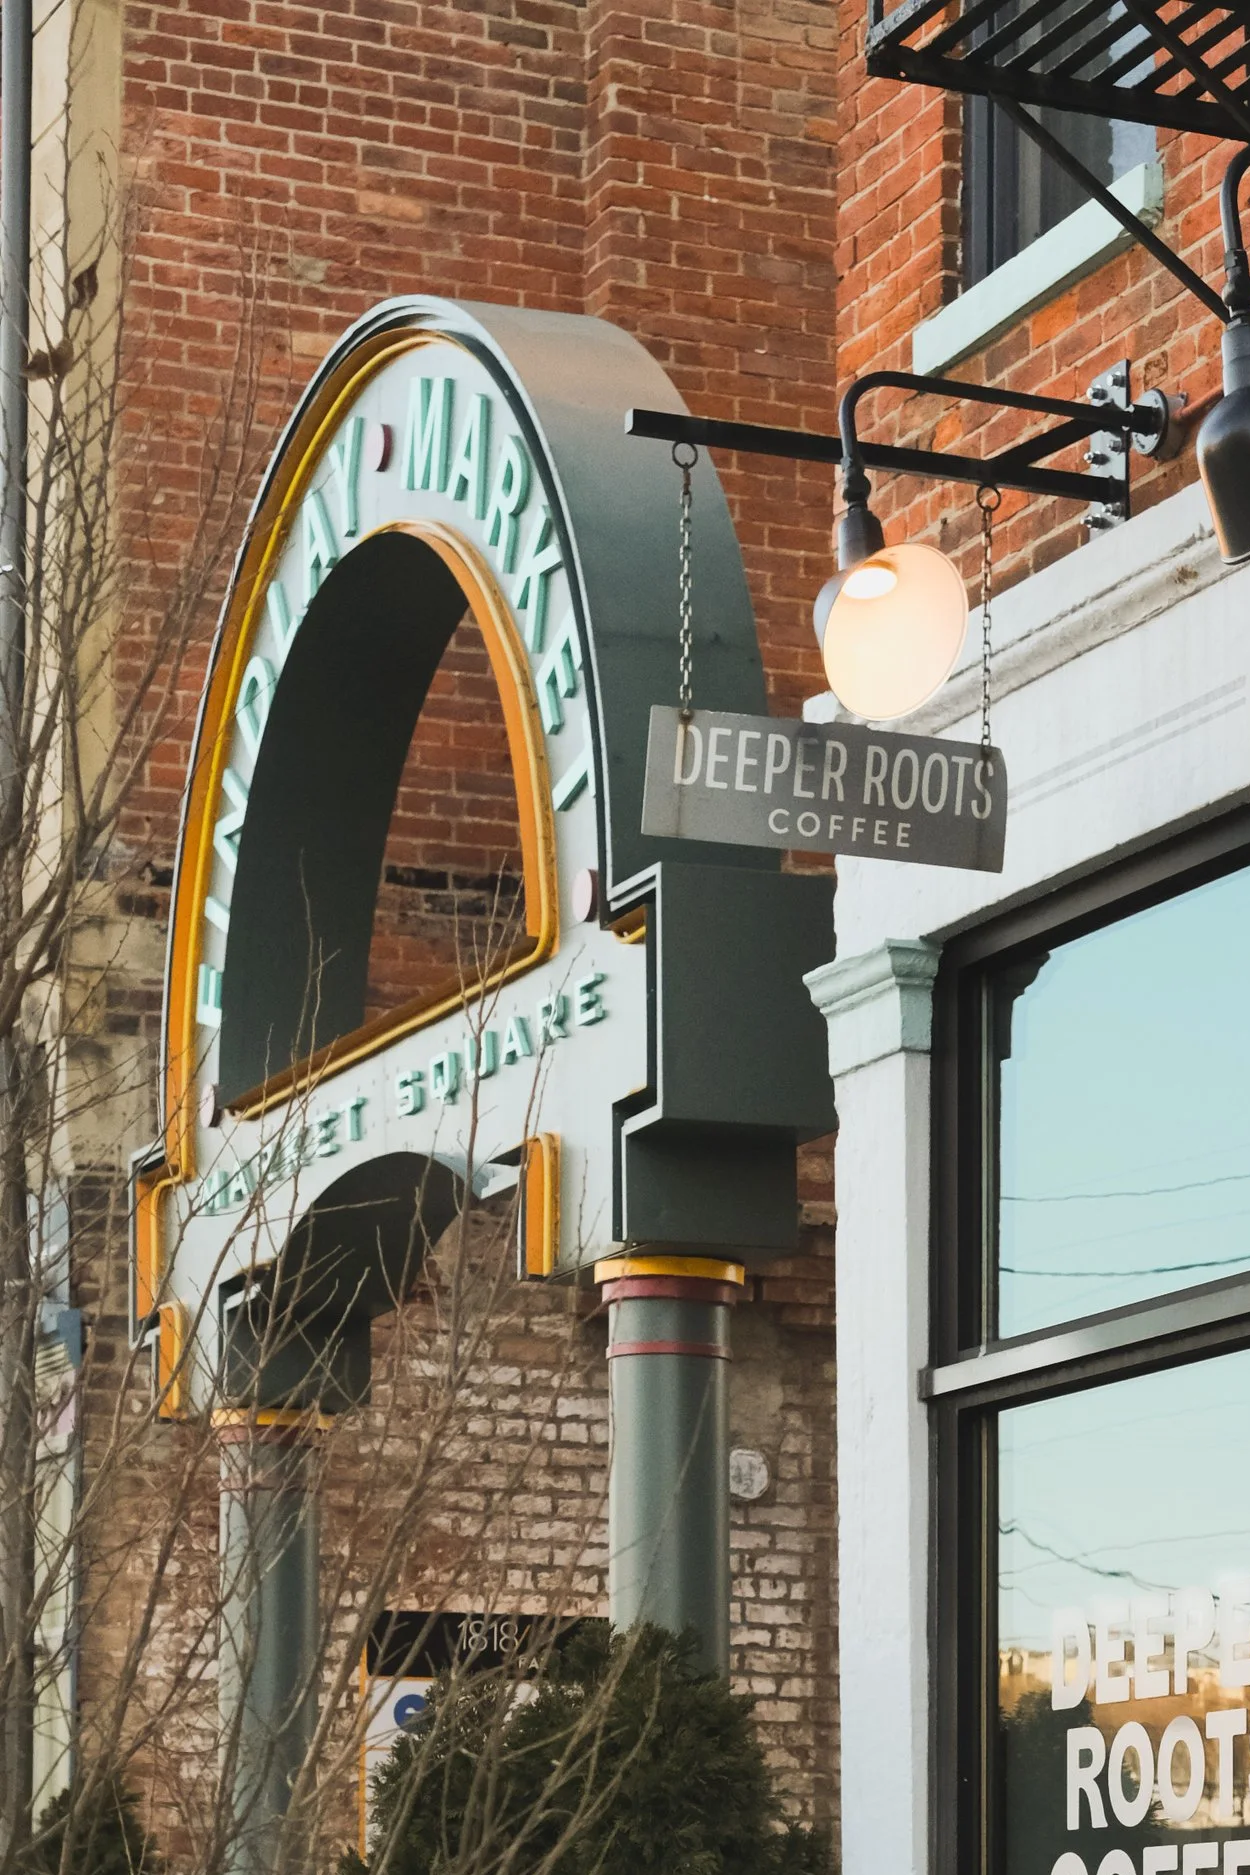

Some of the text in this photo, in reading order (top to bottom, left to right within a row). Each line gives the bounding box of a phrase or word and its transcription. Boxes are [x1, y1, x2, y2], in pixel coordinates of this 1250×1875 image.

[400, 376, 597, 812] MARKET
[673, 722, 994, 820] DEEPER ROOTS
[768, 808, 913, 848] COFFEE
[398, 972, 607, 1117] SQUARE
